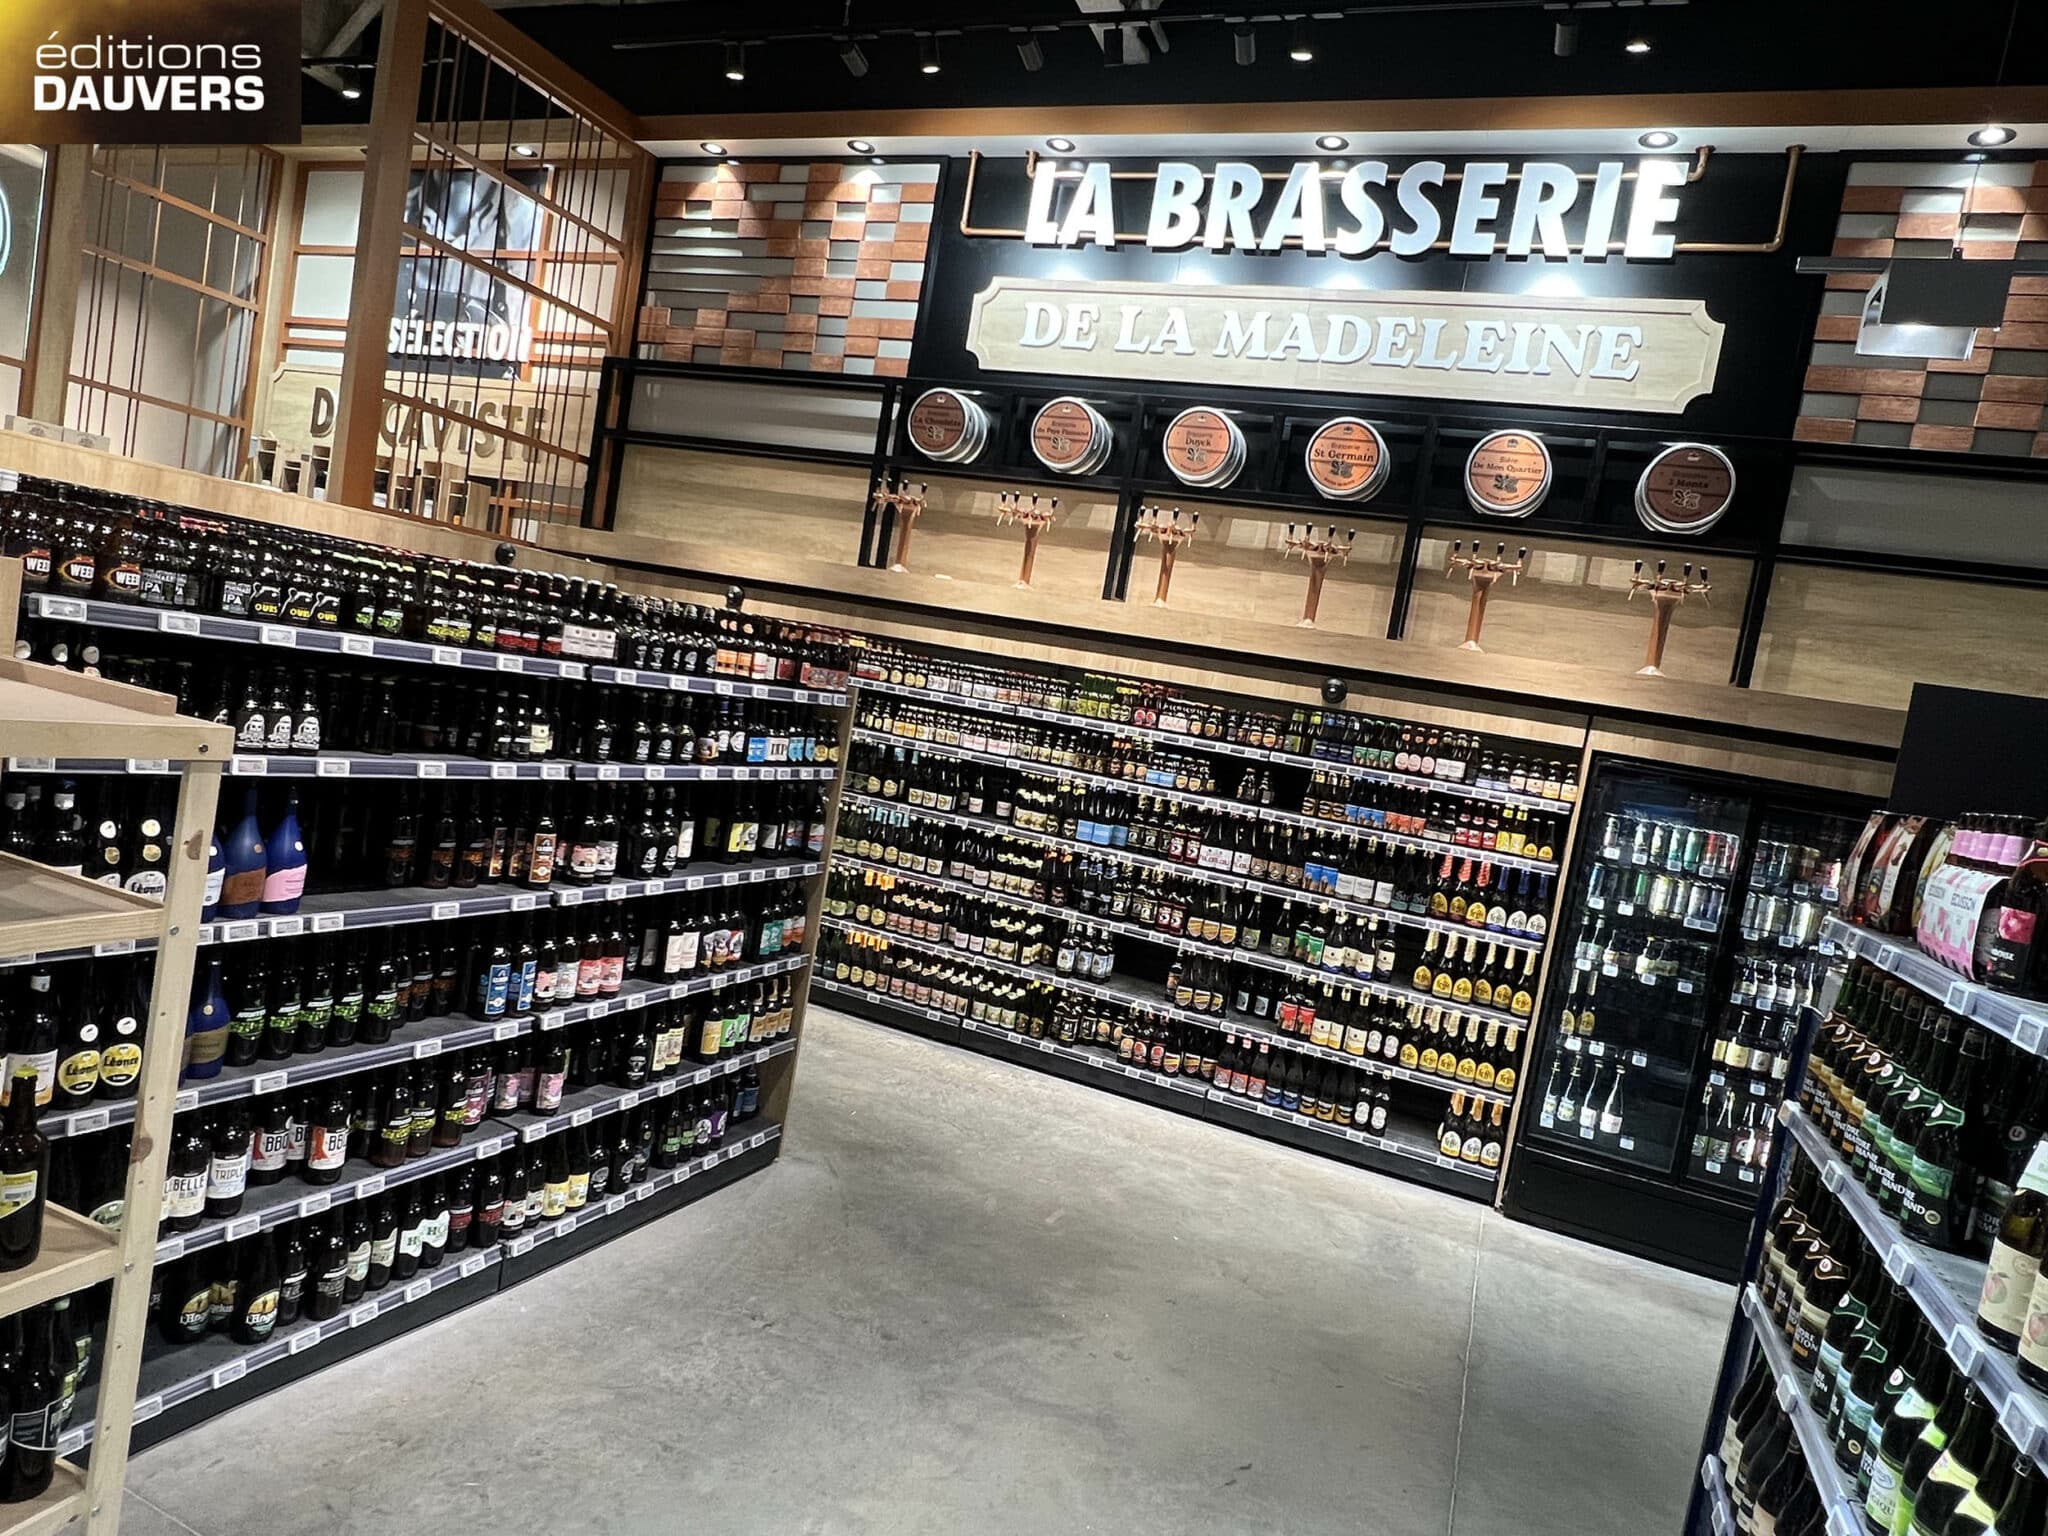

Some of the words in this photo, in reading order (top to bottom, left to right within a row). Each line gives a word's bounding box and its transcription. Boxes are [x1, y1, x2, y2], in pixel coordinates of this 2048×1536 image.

[1024, 161, 1116, 247] LA
[1146, 160, 1690, 259] BRASSERIE
[1018, 301, 1101, 351] DE
[1114, 304, 1195, 356] LA
[1212, 309, 1643, 382] MADELEINE
[1313, 448, 1325, 459] St
[1328, 449, 1375, 463] Germain
[1473, 461, 1485, 470] De
[1486, 463, 1505, 472] Mon
[1506, 463, 1543, 476] Quartier
